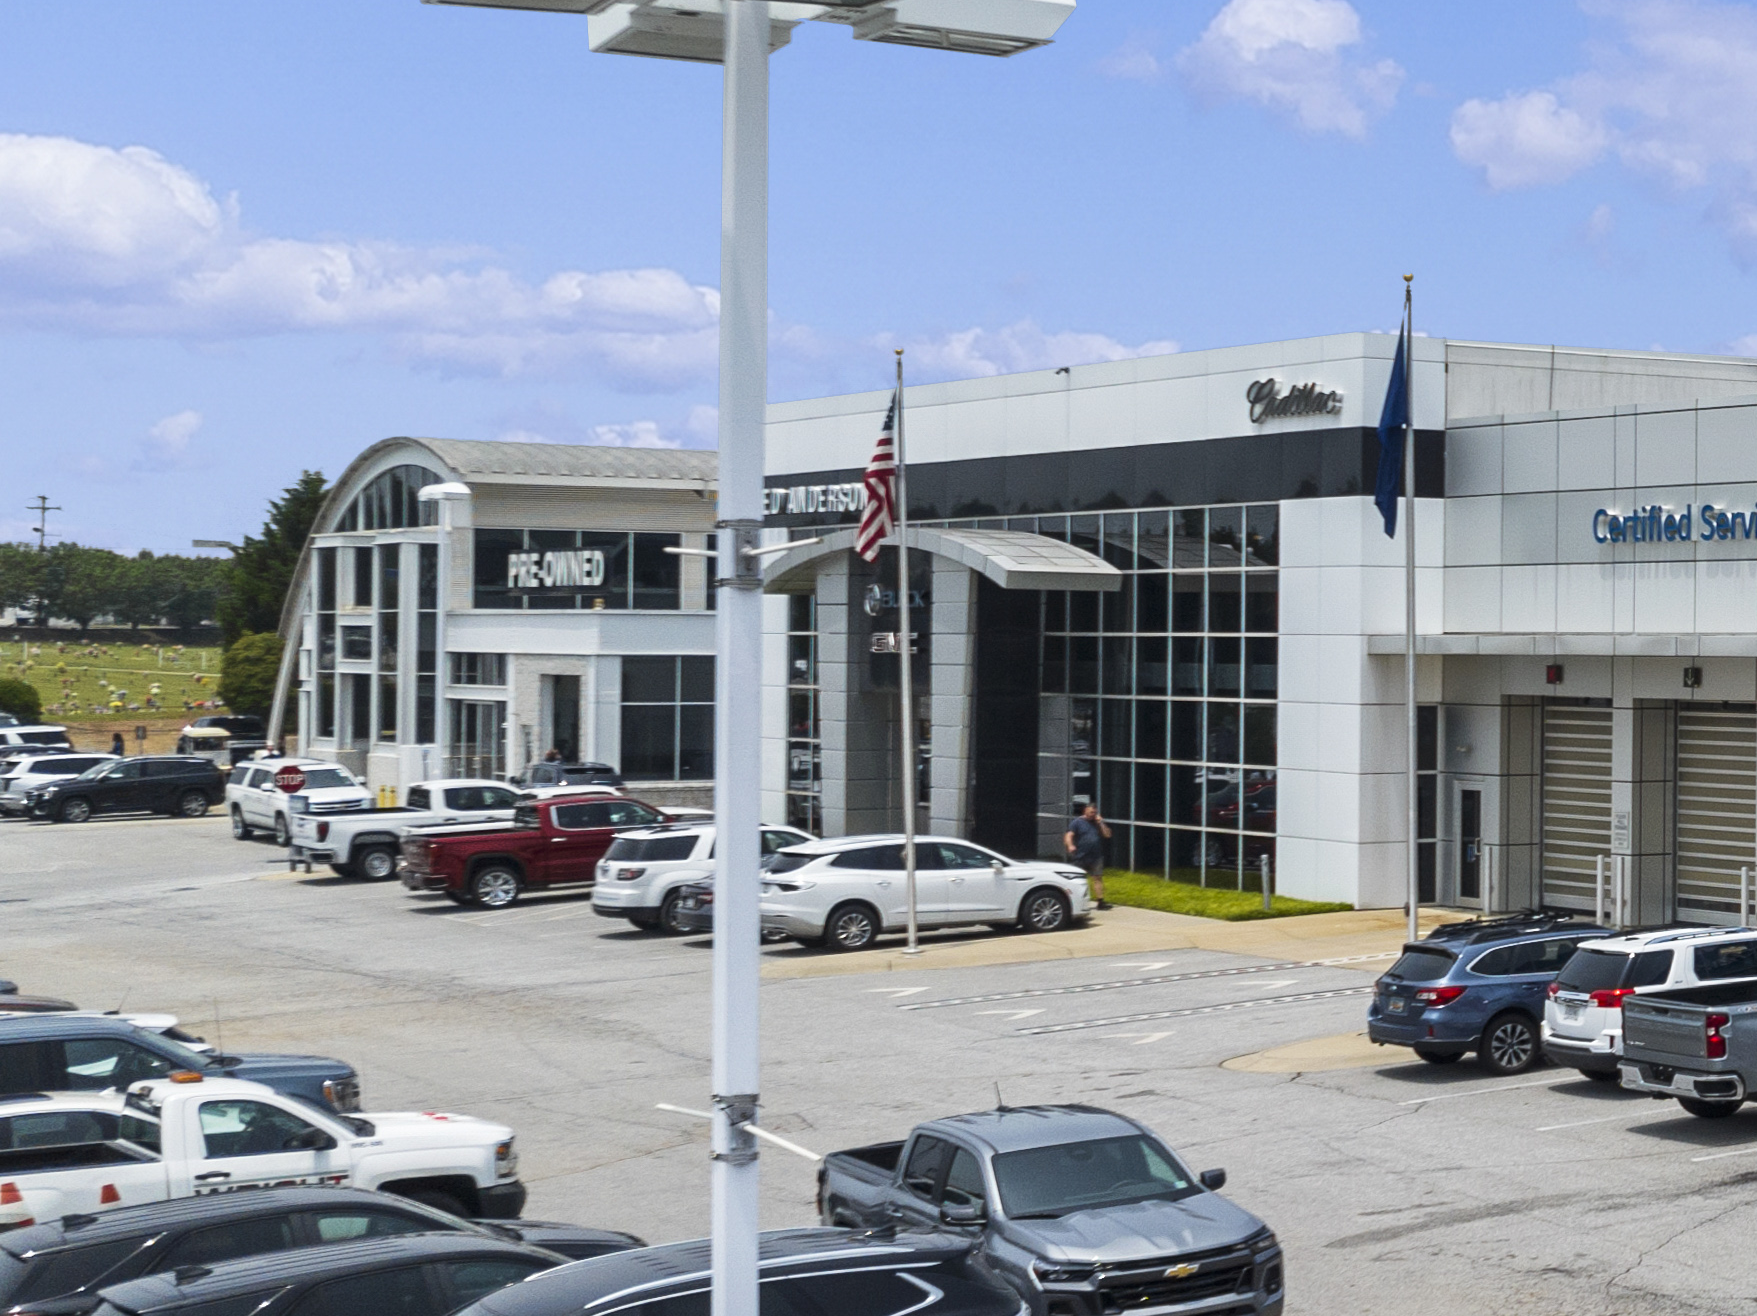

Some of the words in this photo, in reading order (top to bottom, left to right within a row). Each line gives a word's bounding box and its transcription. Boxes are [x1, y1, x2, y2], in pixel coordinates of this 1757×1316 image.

[1246, 377, 1342, 424] Cadillac
[1593, 503, 1692, 544] Certified
[507, 550, 605, 588] PRE-OWNED
[276, 774, 305, 786] STOP
